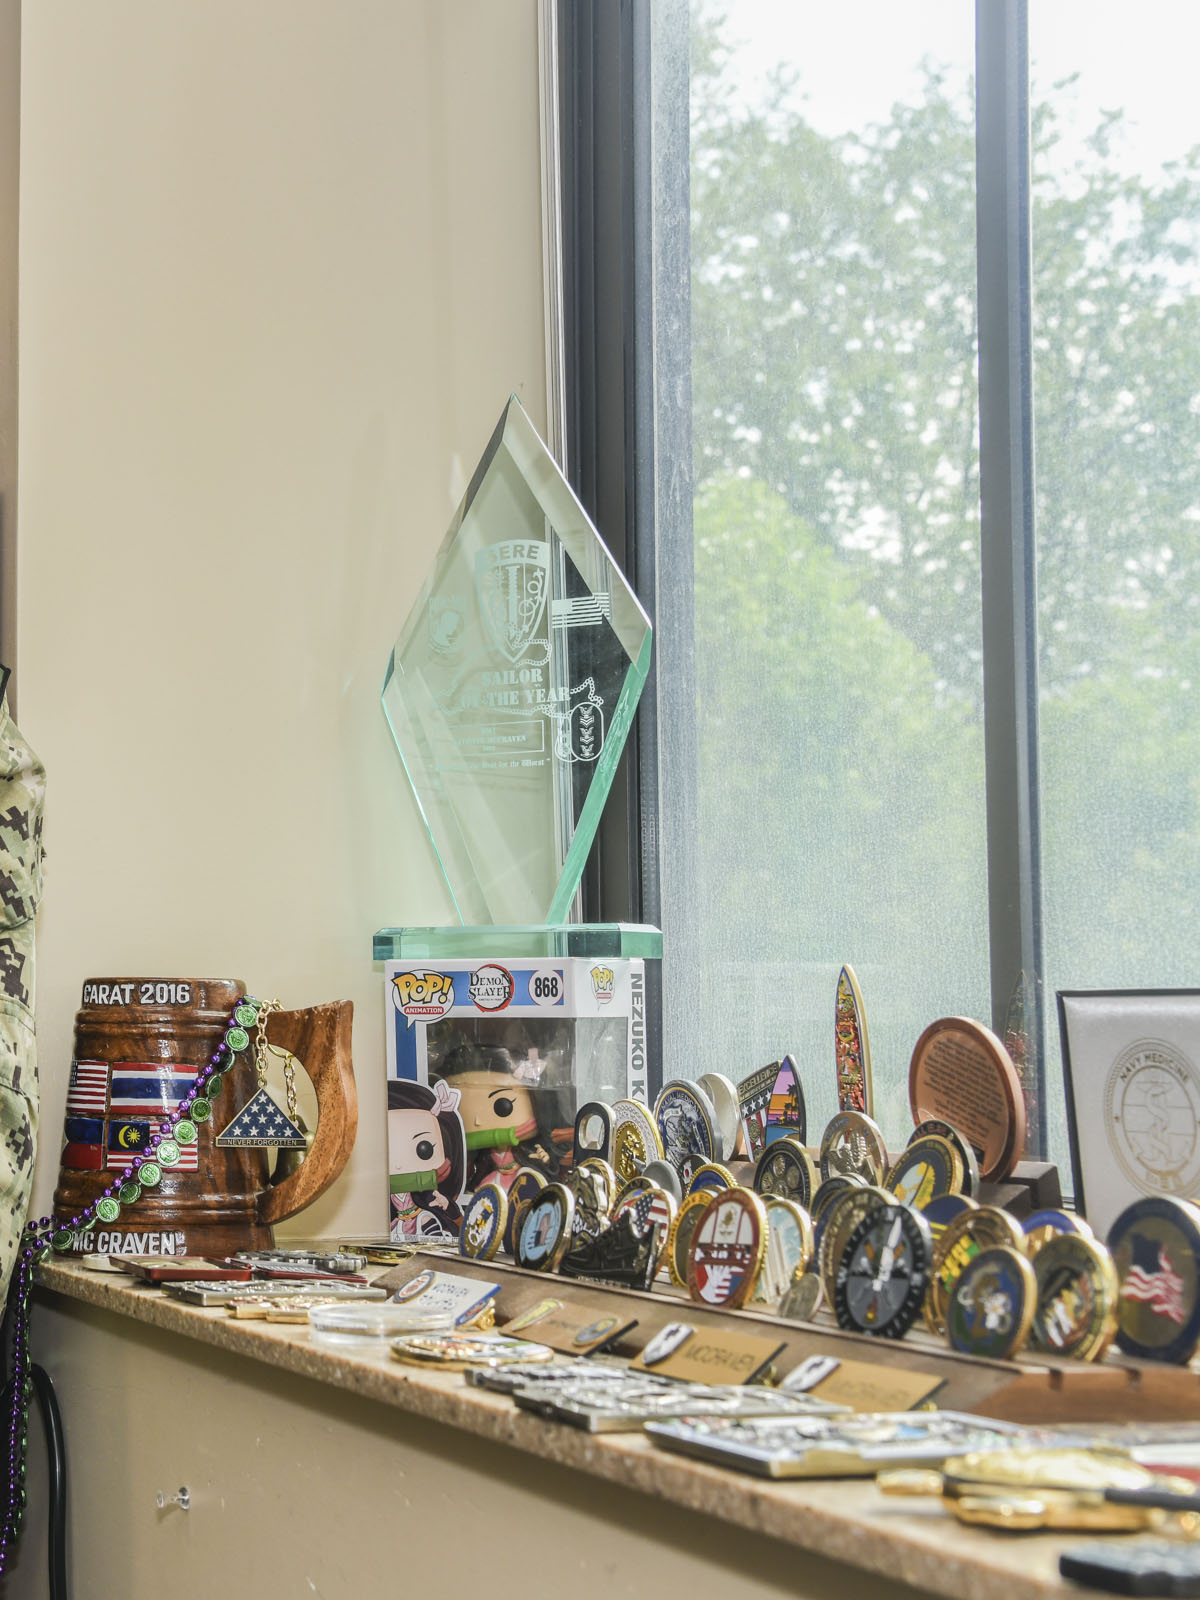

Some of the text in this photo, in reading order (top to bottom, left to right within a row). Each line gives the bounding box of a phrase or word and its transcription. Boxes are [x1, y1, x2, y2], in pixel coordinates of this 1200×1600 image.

[486, 543, 540, 562] SERE
[481, 669, 544, 686] SAILOR
[487, 690, 520, 707] THE
[524, 686, 571, 705] YEAR
[391, 972, 454, 1007] POP!
[469, 972, 511, 987] DEMON
[534, 976, 559, 998] 868
[590, 966, 614, 993] POP!
[83, 983, 190, 1005] CARAT 2016
[468, 986, 512, 1000] SLAYER
[630, 973, 645, 1071] NEZUKO
[1119, 1053, 1191, 1085] NAVY MEDICINE
[97, 1231, 175, 1255] CRAVEN
